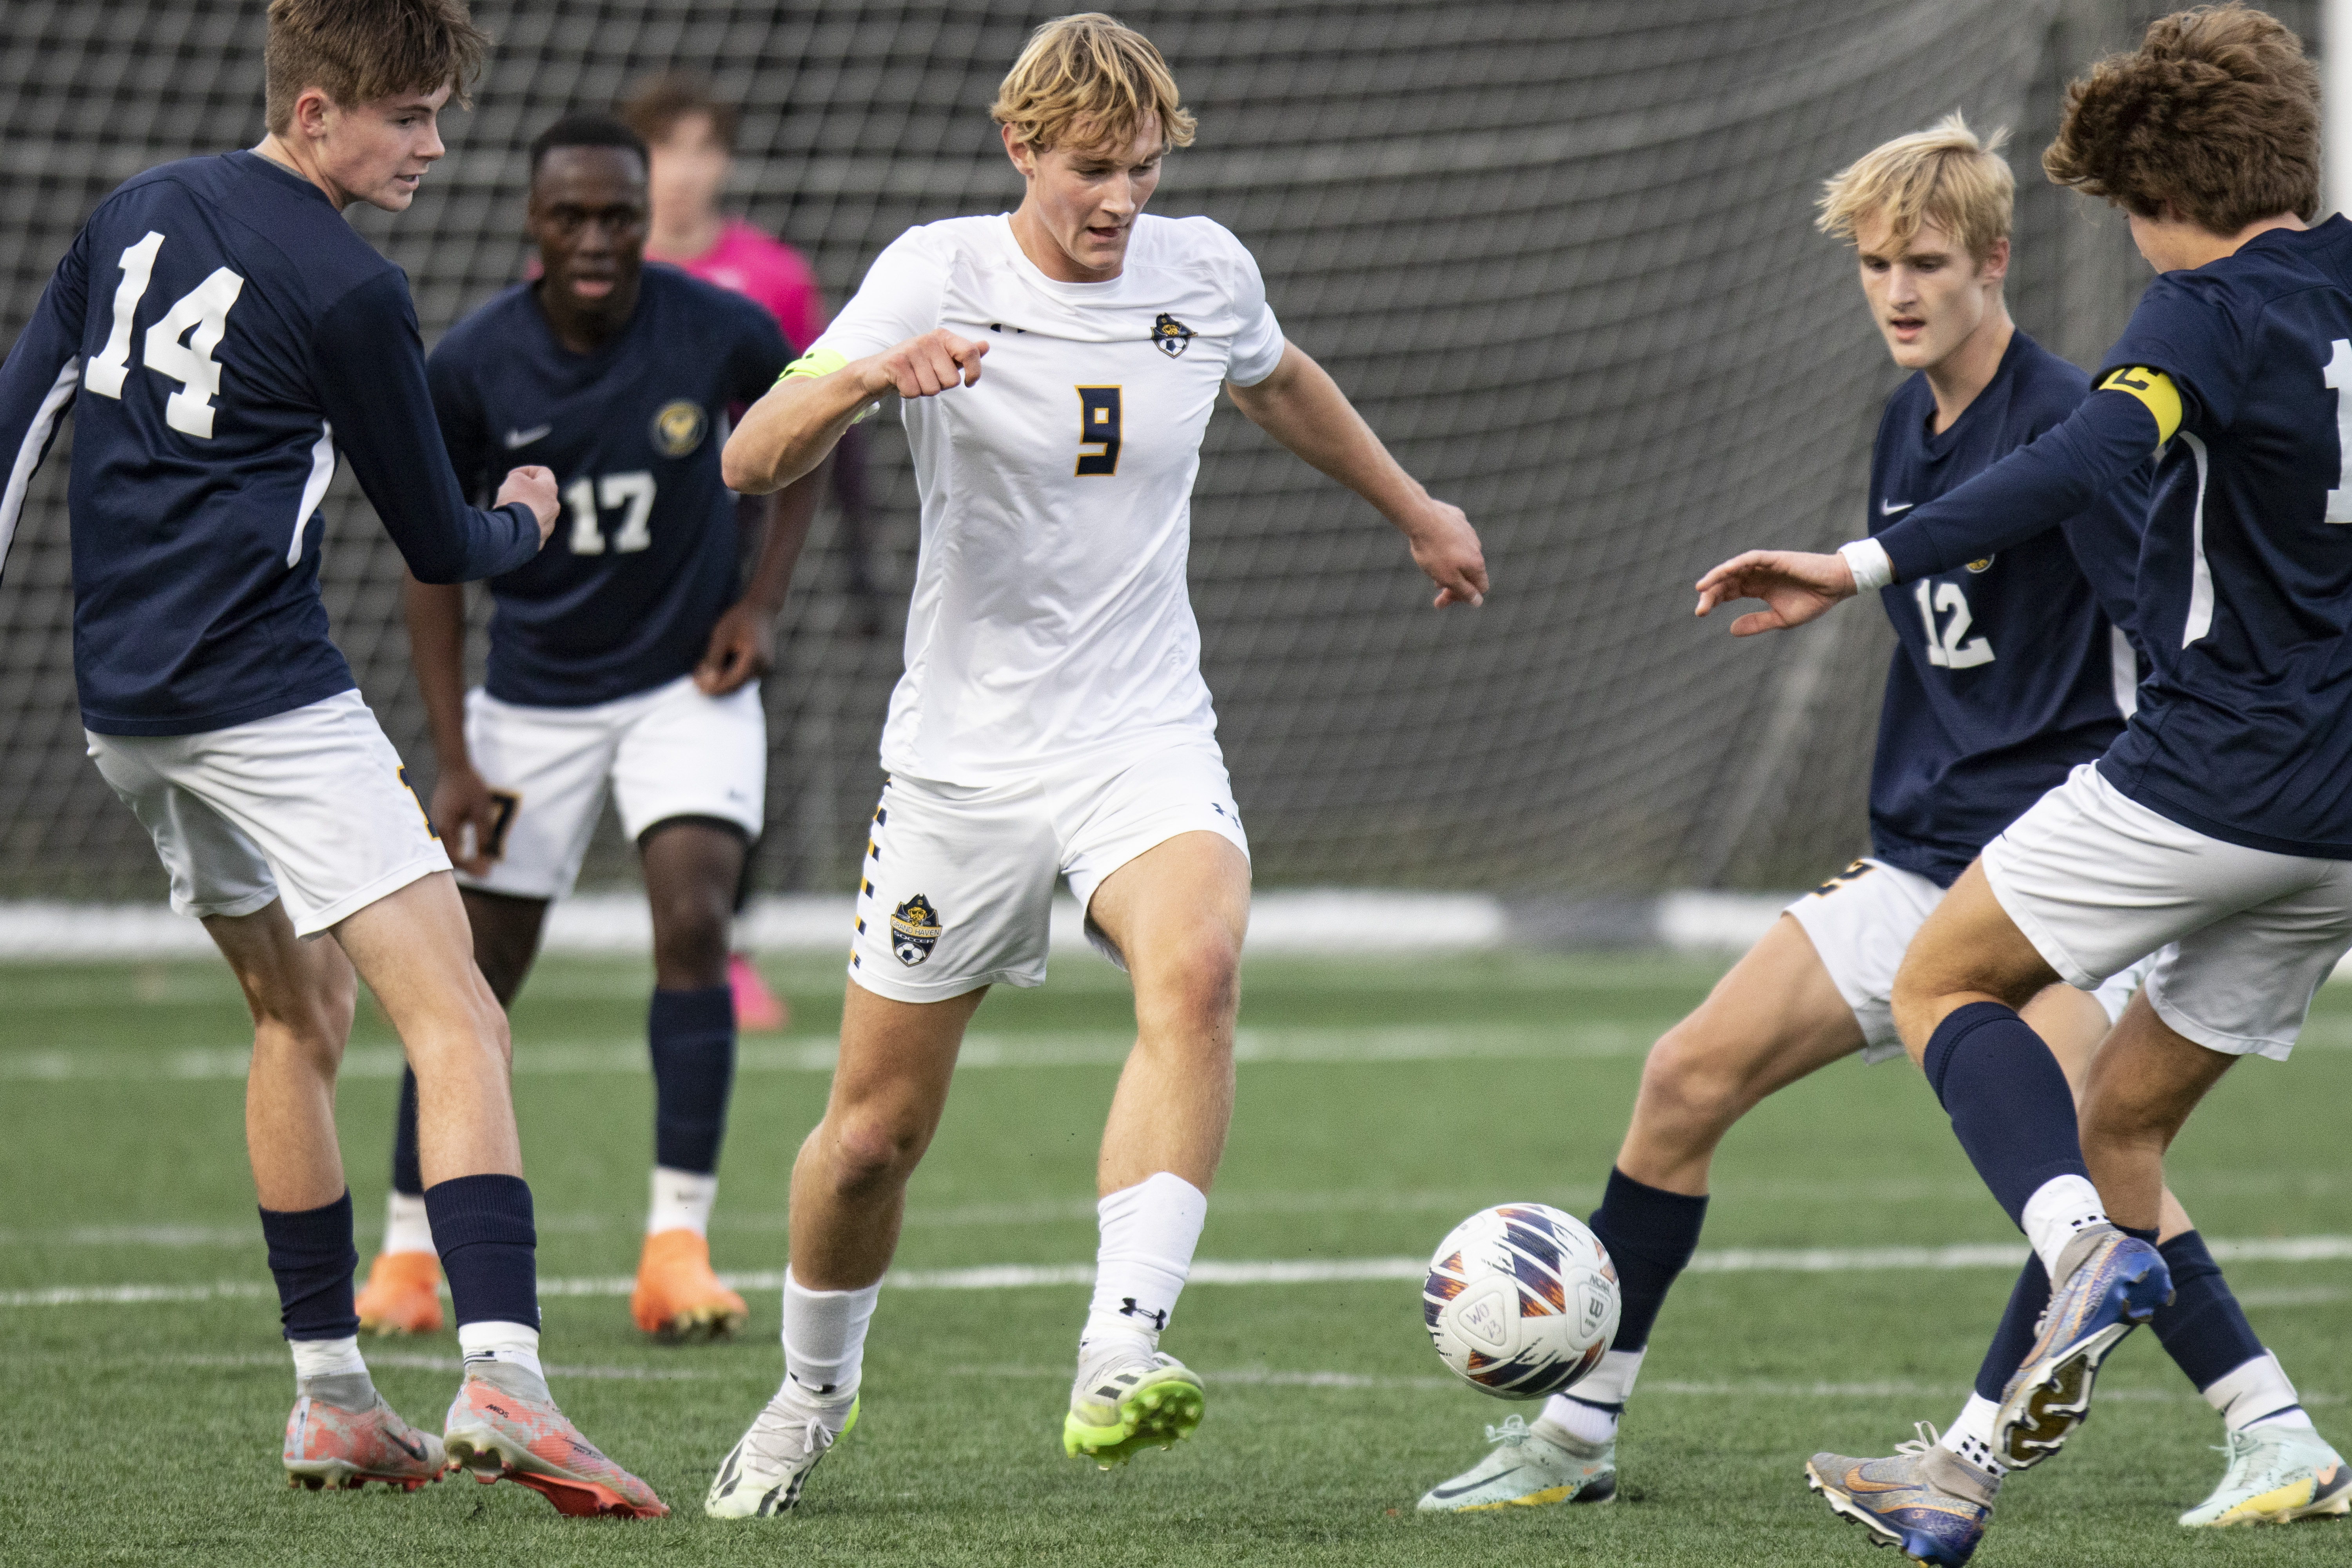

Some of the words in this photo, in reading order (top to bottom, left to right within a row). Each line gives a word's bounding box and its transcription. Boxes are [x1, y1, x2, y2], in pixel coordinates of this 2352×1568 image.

[84, 231, 244, 439] 14
[1074, 385, 1123, 477] 9
[563, 470, 657, 555] 17
[1916, 579, 1996, 668] 12
[892, 919, 913, 933] GRAND
[893, 930, 935, 944] SOCCER
[1483, 1319, 1502, 1339] 23
